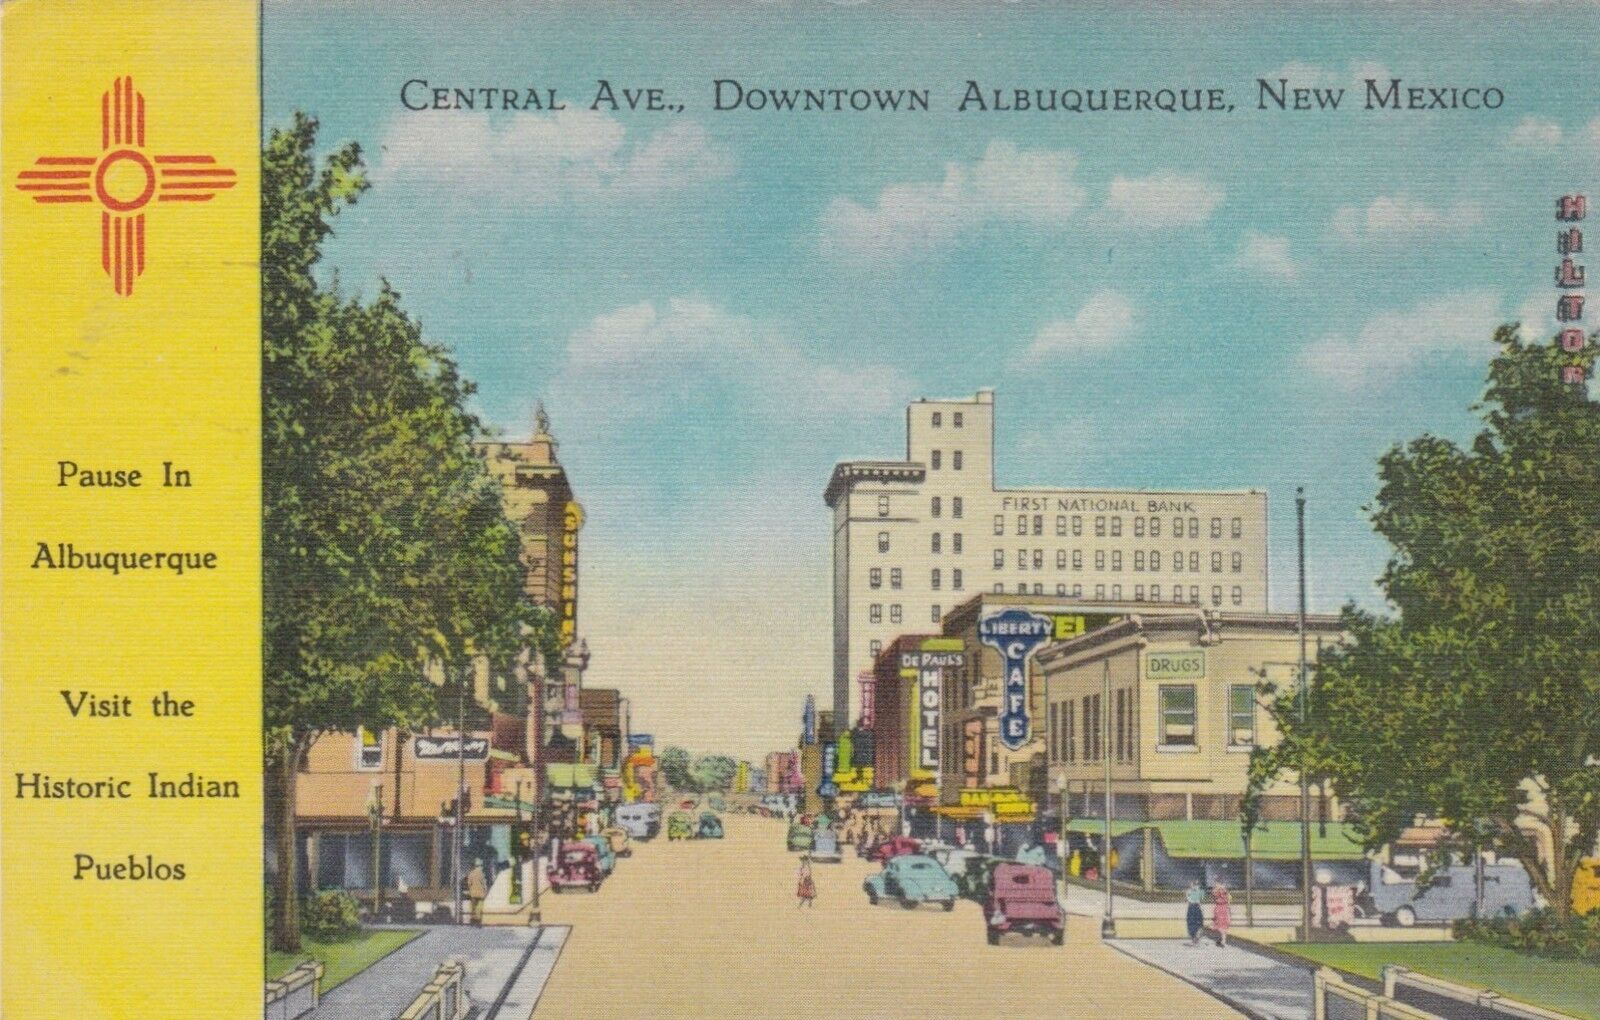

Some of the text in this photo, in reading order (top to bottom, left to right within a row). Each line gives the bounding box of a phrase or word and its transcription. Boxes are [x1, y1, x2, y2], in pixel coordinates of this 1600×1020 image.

[1557, 195, 1586, 386] HILTON
[1003, 497, 1197, 514] FIRST NATIONAL BANK
[980, 620, 1053, 636] LIBERTY
[1007, 642, 1025, 737] CAFE
[1150, 657, 1200, 673] DRUGS
[922, 669, 939, 767] HOTEL
